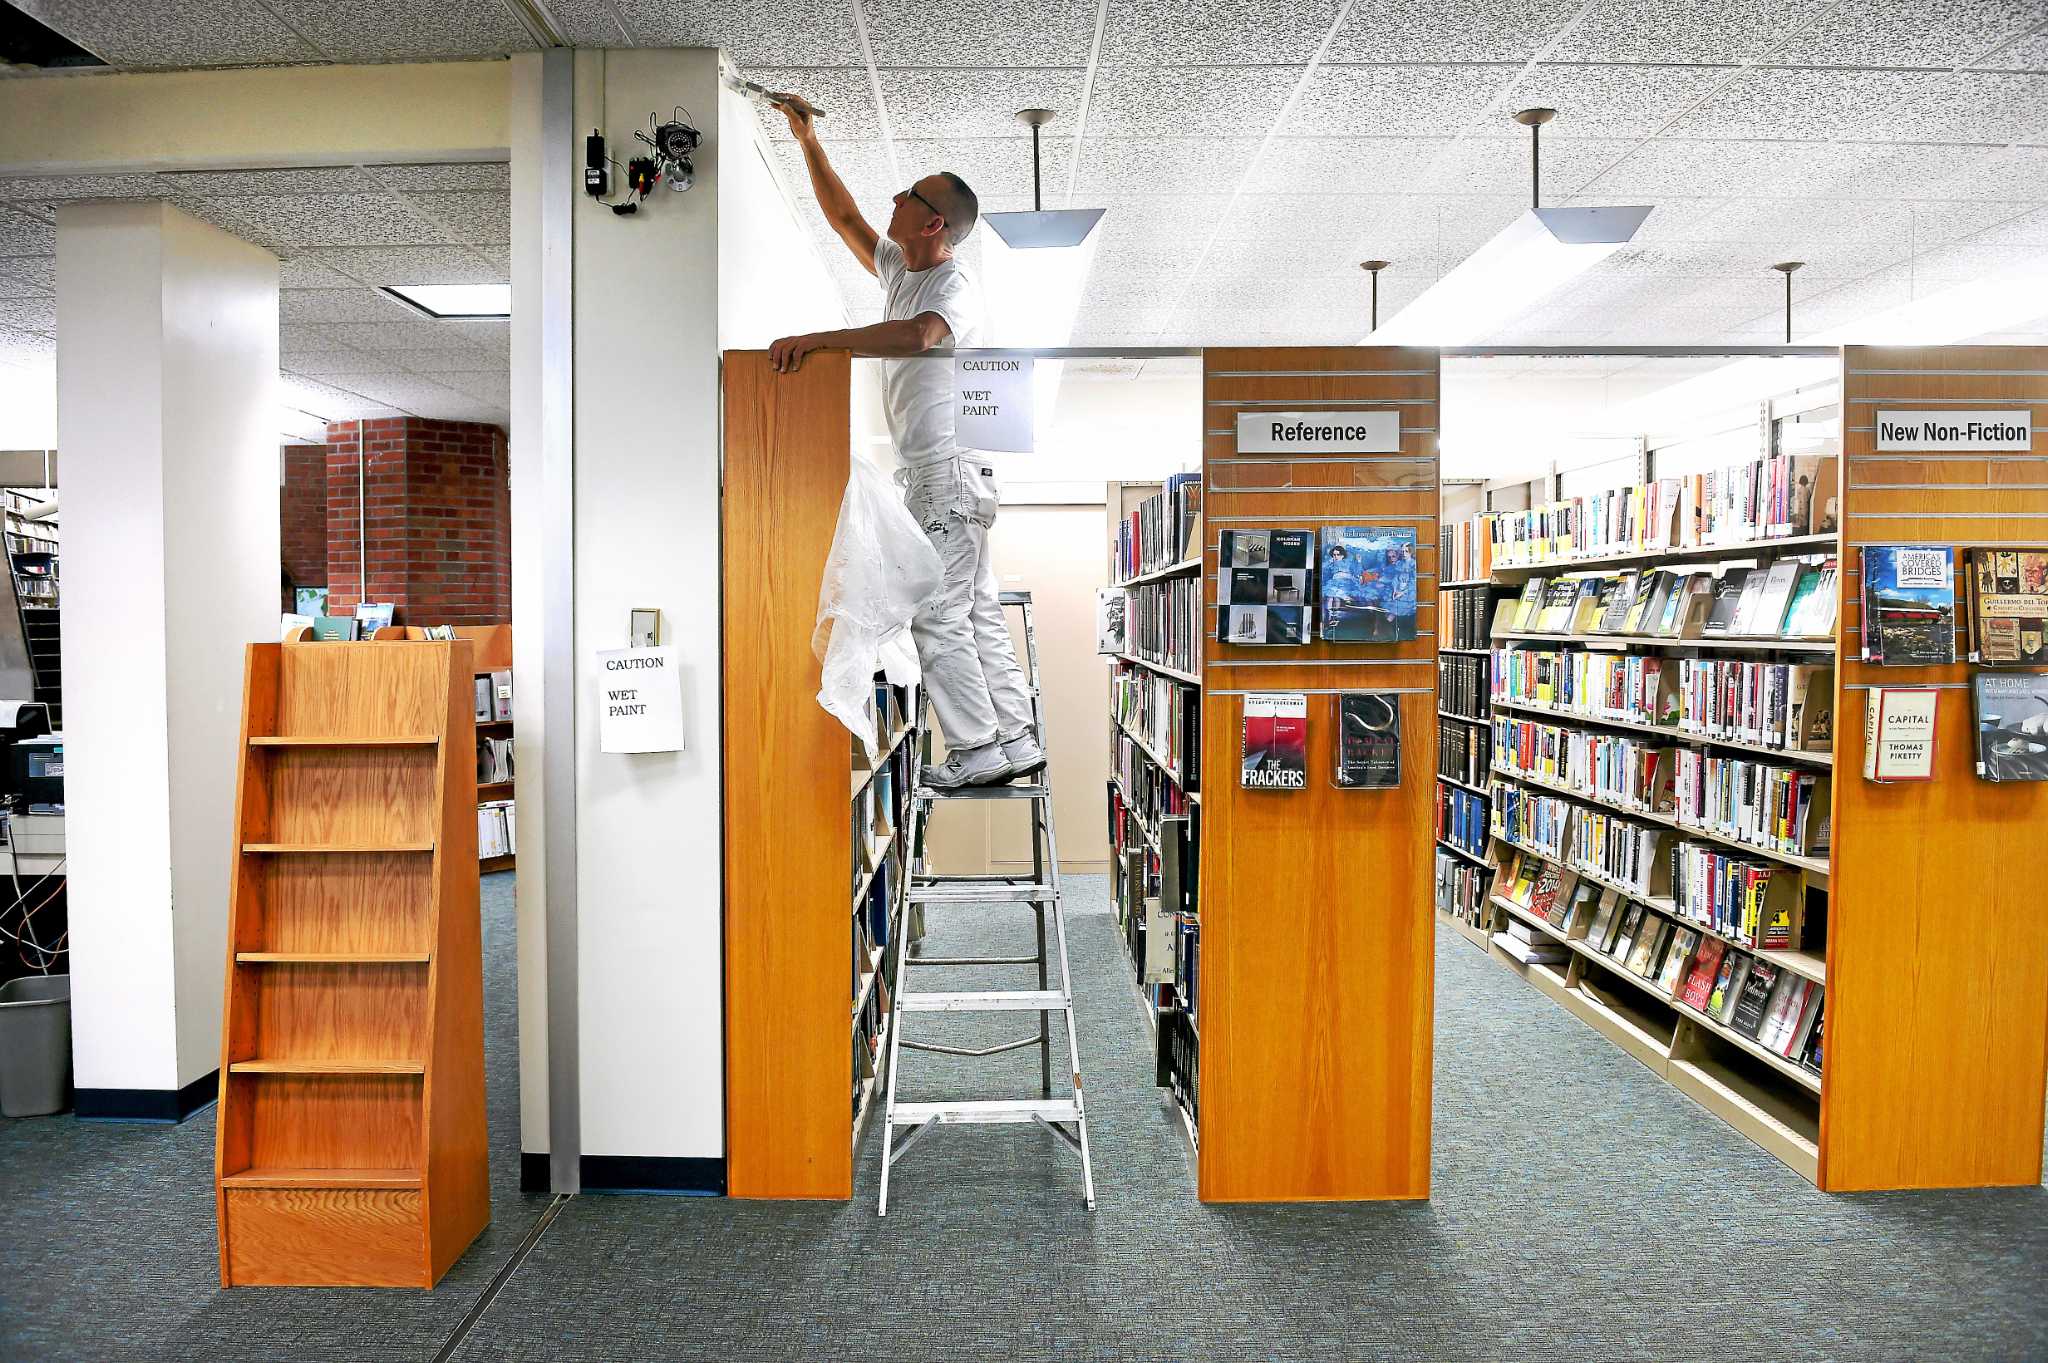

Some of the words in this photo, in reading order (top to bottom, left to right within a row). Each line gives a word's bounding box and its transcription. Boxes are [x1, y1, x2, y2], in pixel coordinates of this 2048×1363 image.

[962, 360, 1020, 371] CAUTION
[962, 391, 992, 401] WET
[962, 405, 999, 416] PAINT
[1271, 421, 1367, 441] Reference
[1881, 422, 1919, 441] New
[1923, 422, 2027, 441] Non-Fiction
[1902, 559, 1942, 568] COVERED
[1902, 567, 1942, 576] BRIDGES
[606, 657, 664, 671] CAUTION
[1984, 678, 1996, 687] AT
[2000, 678, 2030, 688] HOME
[608, 689, 637, 701] WET
[609, 704, 647, 717] PAINT
[1888, 715, 1929, 724] CAPITAL
[1889, 743, 1923, 751] THOMAS
[1890, 752, 1922, 760] PIKETTY
[1267, 760, 1281, 770] THE
[1243, 769, 1304, 787] FRACKERS
[1687, 974, 1712, 993] FLASH
